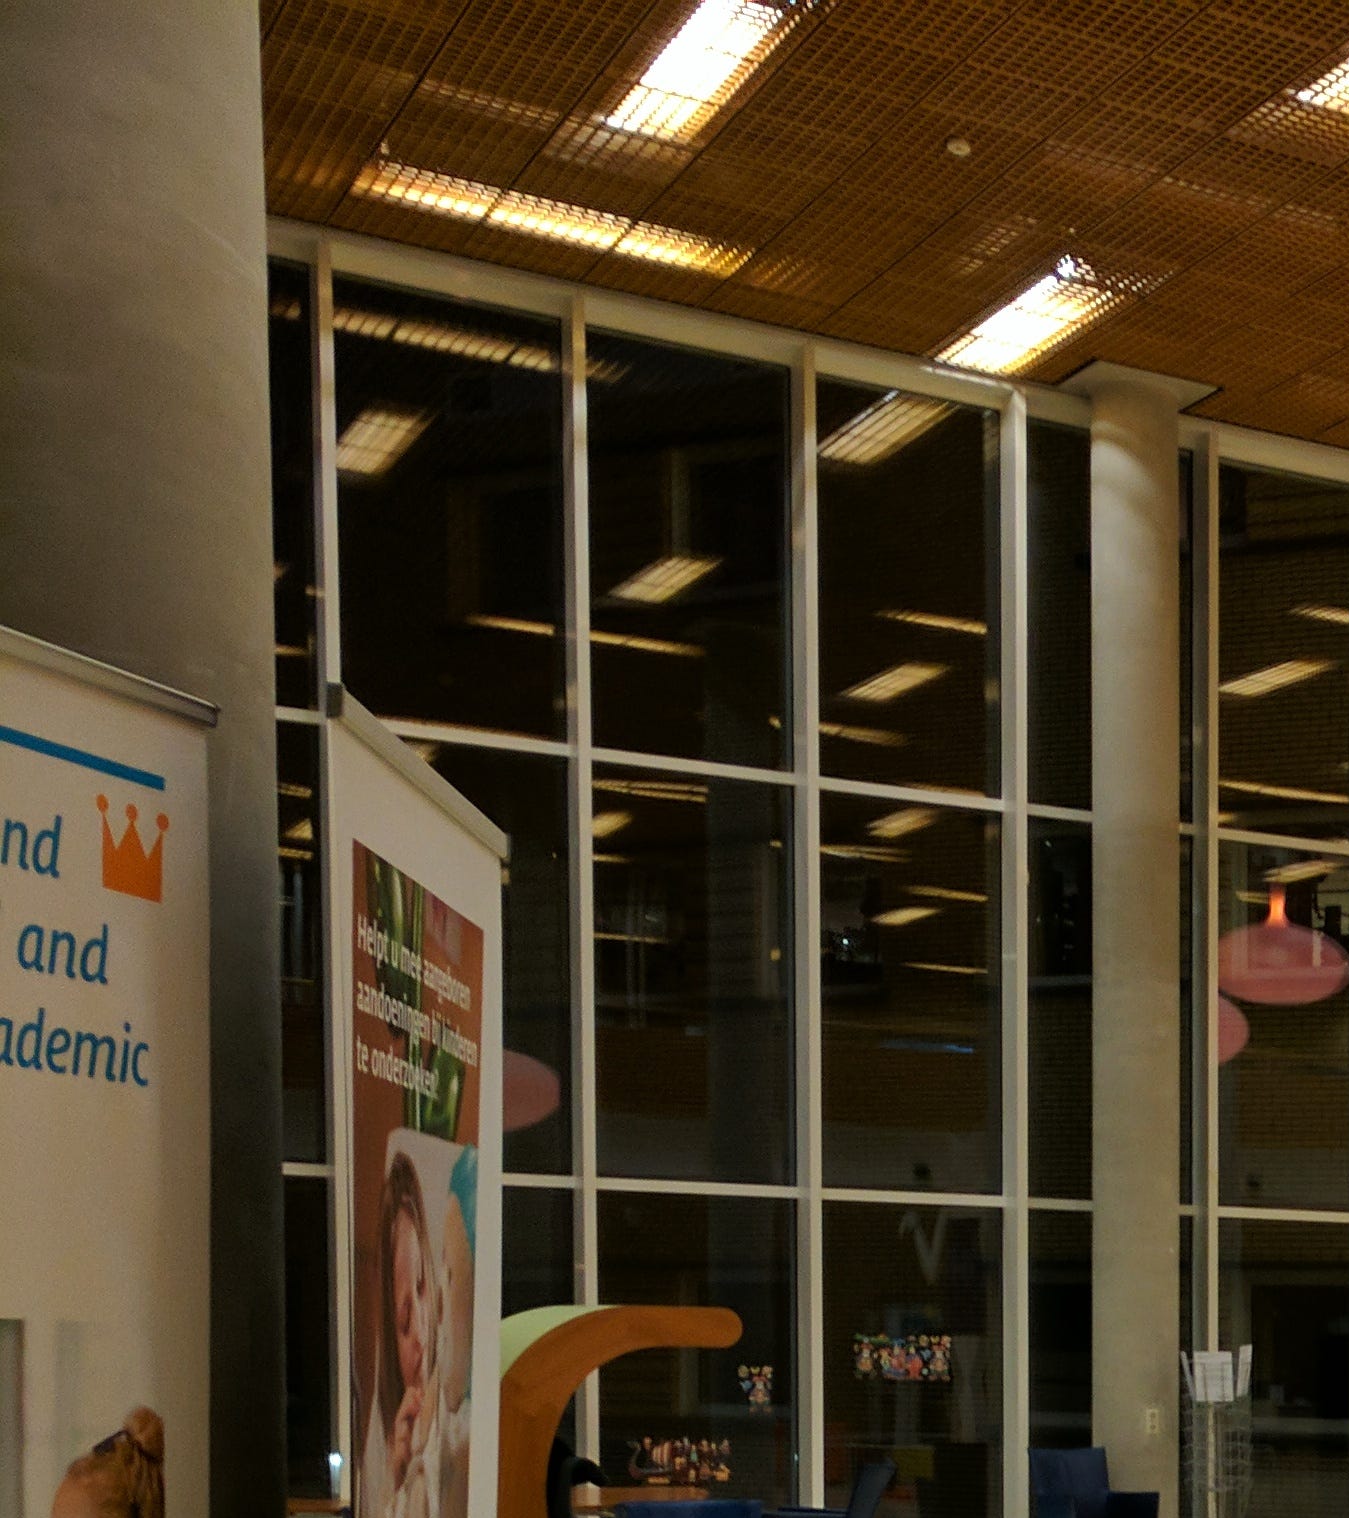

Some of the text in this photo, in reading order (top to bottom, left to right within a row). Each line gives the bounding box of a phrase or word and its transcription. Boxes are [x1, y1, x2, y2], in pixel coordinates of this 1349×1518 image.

[17, 923, 109, 985] and
[357, 912, 389, 969] Helpt
[391, 939, 399, 970] u
[357, 1034, 369, 1074] te
